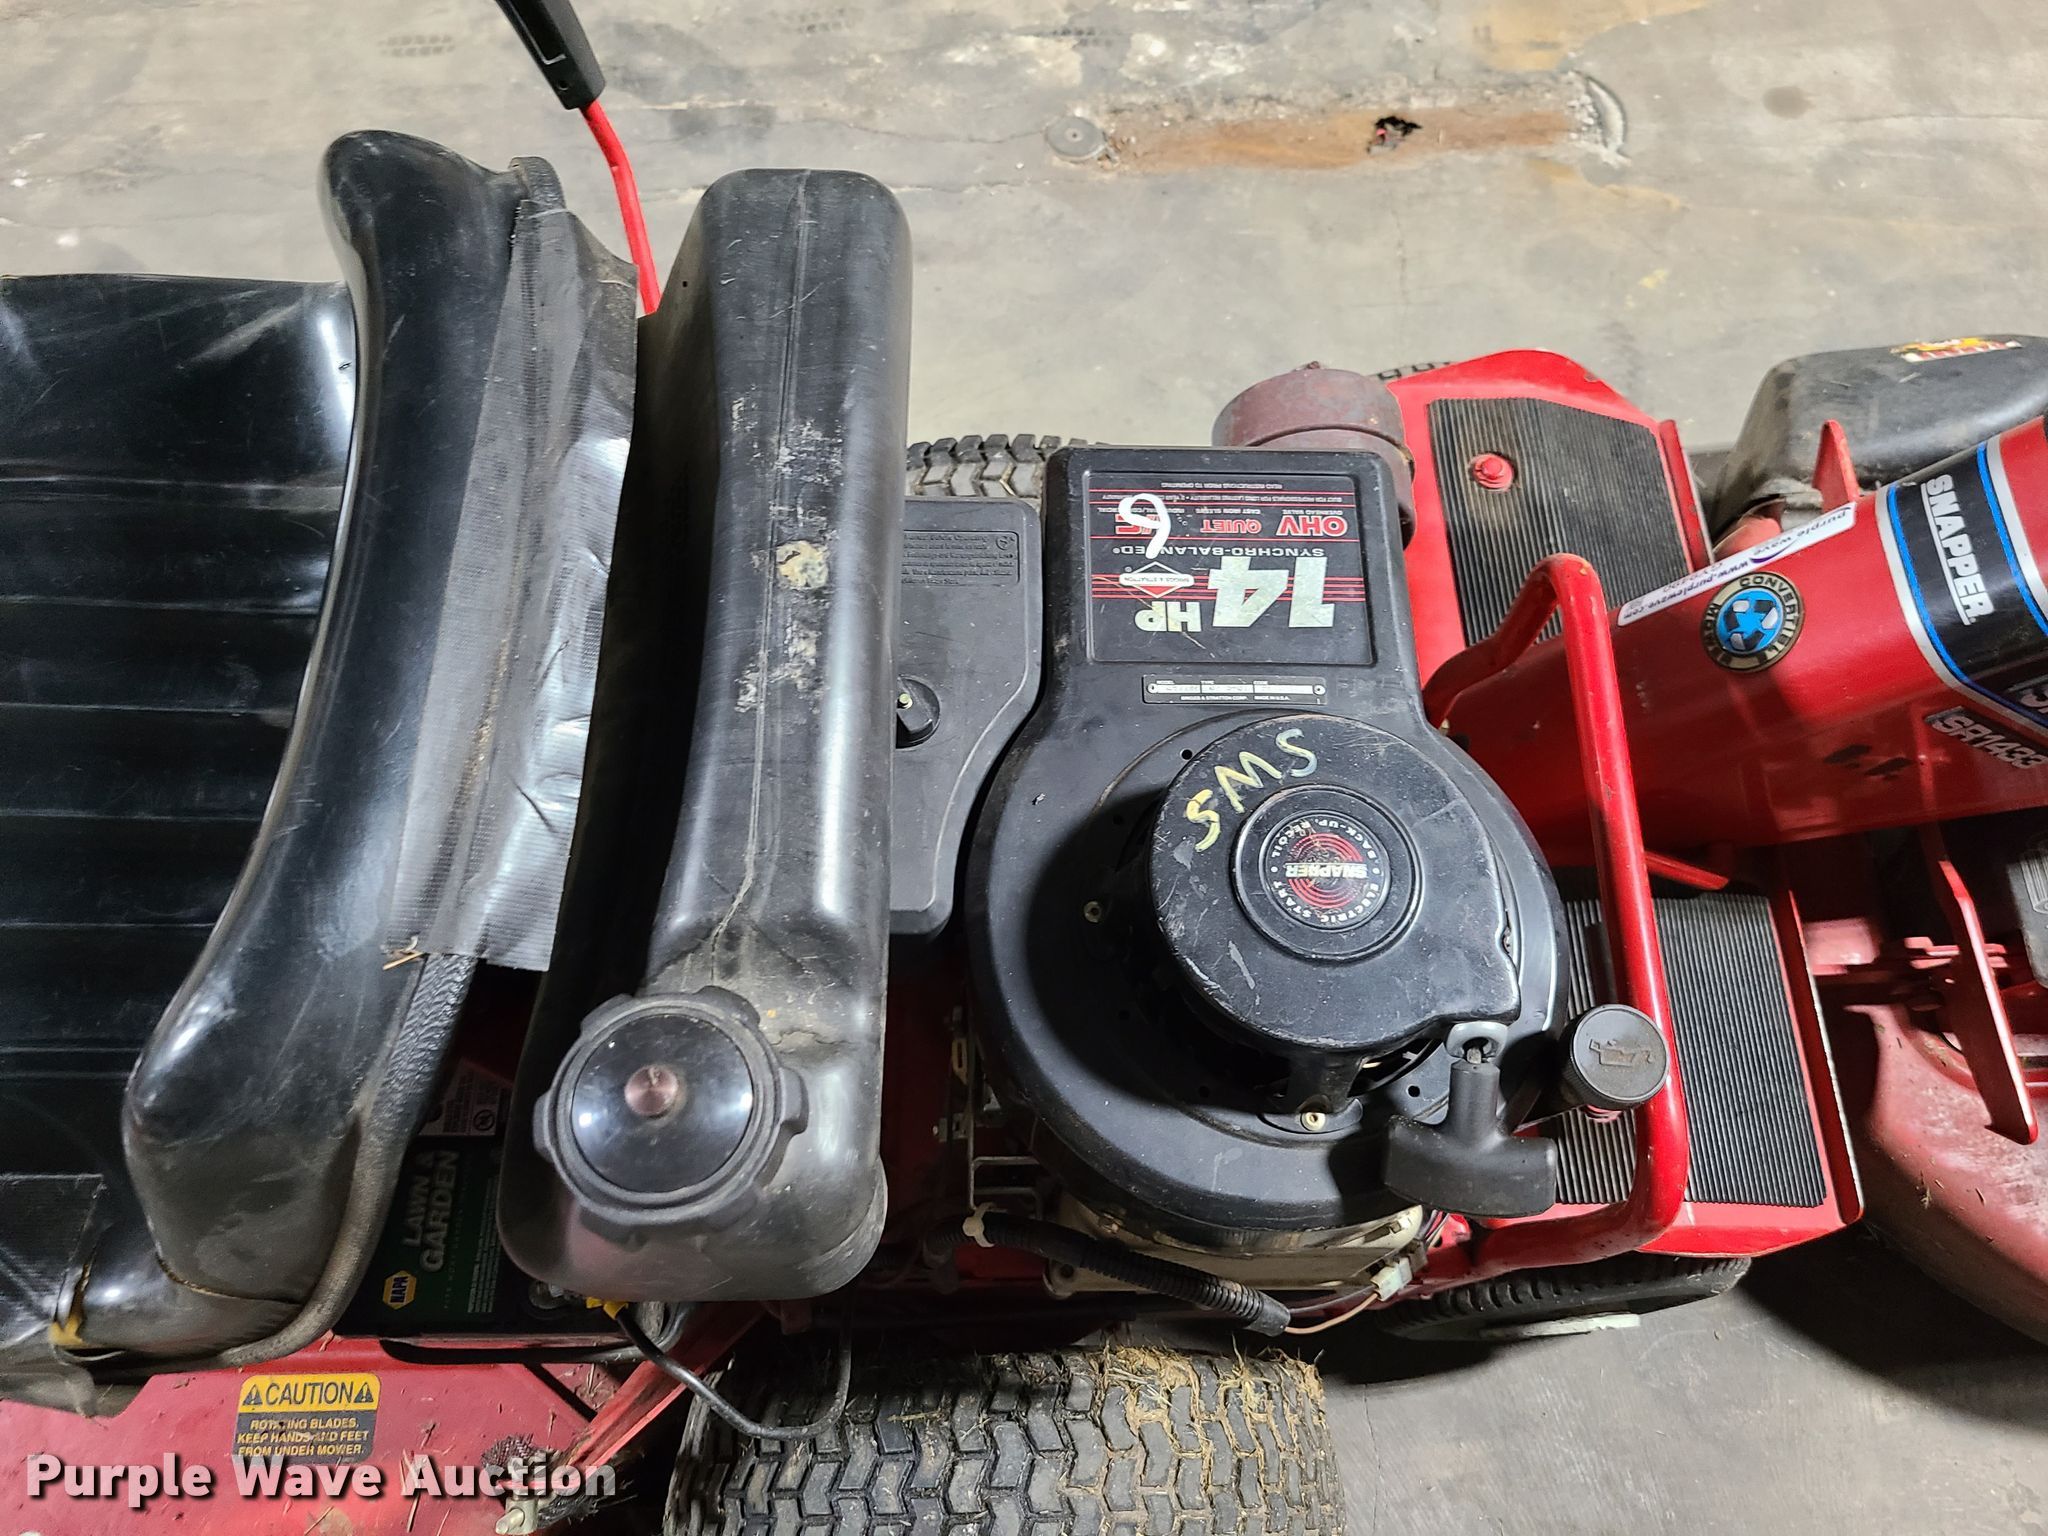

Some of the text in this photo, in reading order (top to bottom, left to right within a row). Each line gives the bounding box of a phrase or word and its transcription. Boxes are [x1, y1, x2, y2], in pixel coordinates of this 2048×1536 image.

[1201, 519, 1262, 534] QUIET
[1276, 515, 1348, 537] OHV
[1753, 510, 1848, 556] purple wave
[1208, 556, 1335, 628] 14
[1134, 602, 1201, 632] HP
[1185, 727, 1318, 853] SMS
[1273, 881, 1379, 923] ELECTRIC START
[403, 1173, 431, 1248] LAWN
[419, 1149, 460, 1273] GARDEN
[390, 1276, 409, 1304] NAPA
[265, 1381, 353, 1405] CAUTION
[237, 1432, 269, 1444] KEEP
[270, 1431, 310, 1443] HANDS
[340, 1430, 369, 1441] FEET
[238, 1446, 271, 1458] FROM
[274, 1445, 314, 1456] UNDER
